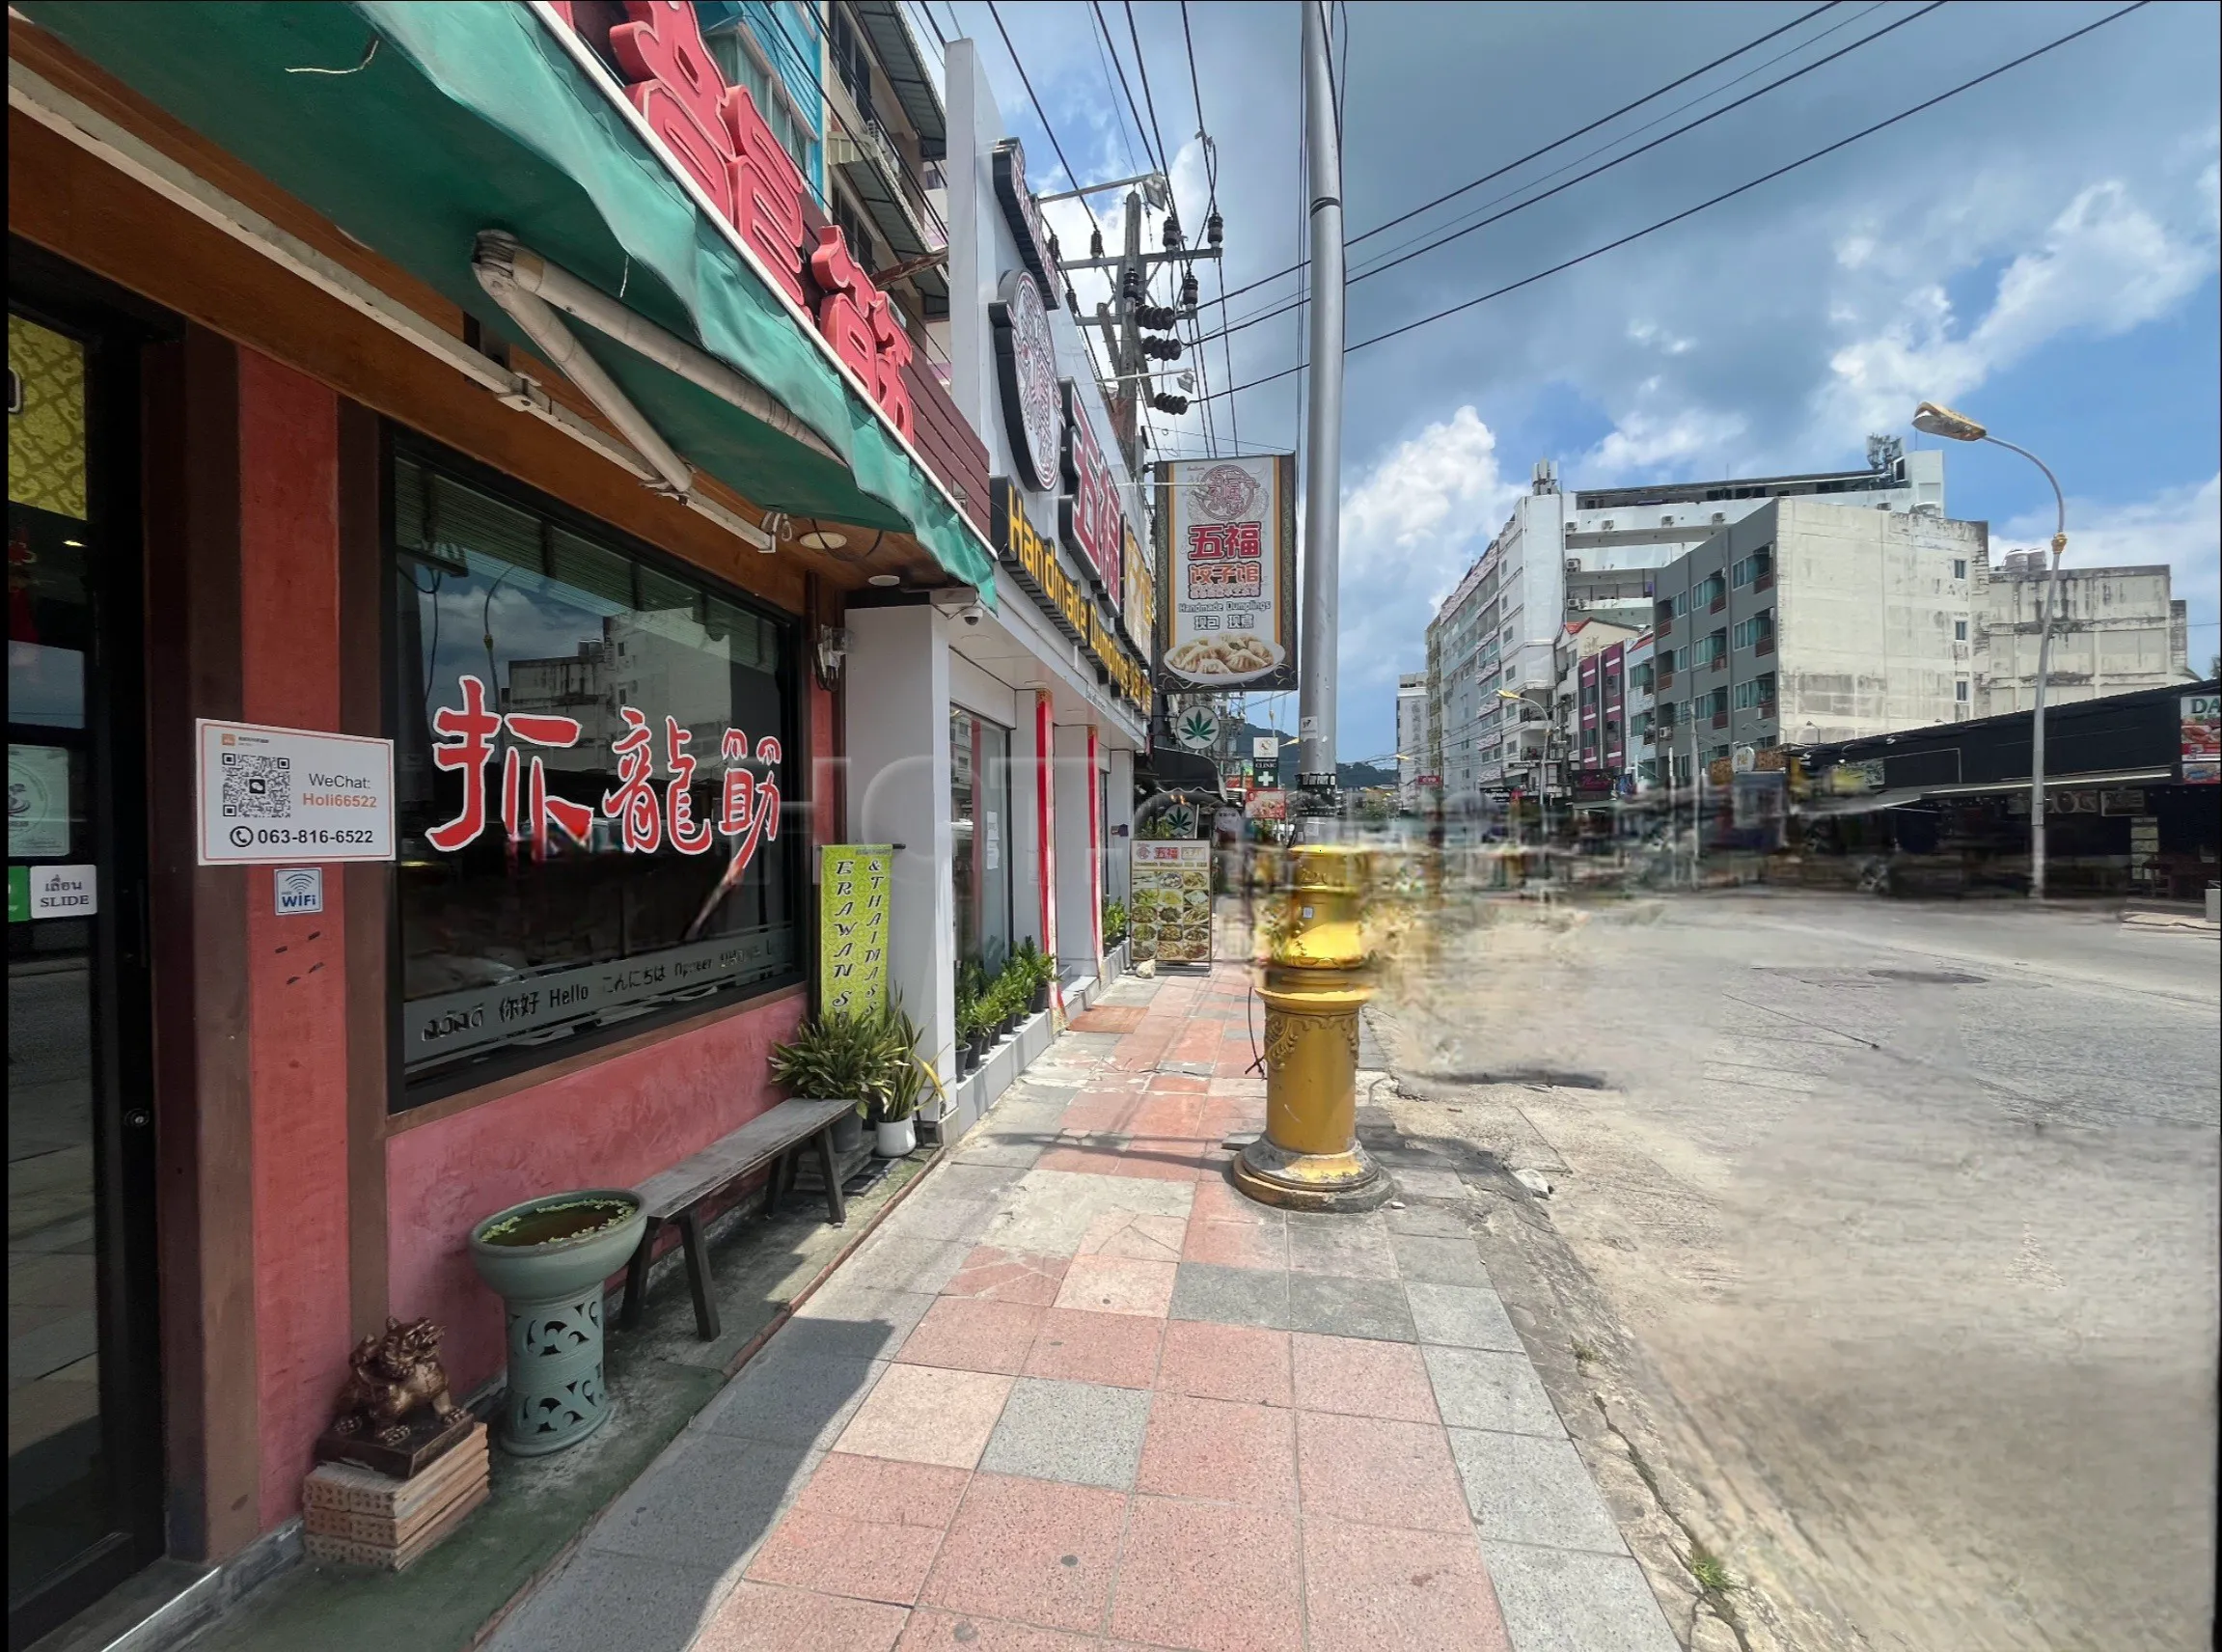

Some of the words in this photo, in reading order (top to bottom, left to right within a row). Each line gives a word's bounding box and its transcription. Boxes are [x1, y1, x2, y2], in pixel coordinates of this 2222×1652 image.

[1188, 522, 1262, 561] 五福
[1007, 484, 1088, 641] Handmade
[1178, 601, 1223, 613] Handmade
[1226, 599, 1271, 613] Dumplings
[309, 773, 371, 789] WeChat:
[303, 792, 378, 809] Holi66522
[258, 829, 373, 844] 063-816-6522
[868, 859, 881, 871] &
[40, 894, 90, 908] SLIDE
[867, 876, 885, 944] THAI
[834, 860, 858, 978] ERAWAN
[498, 990, 540, 1023] 你好
[549, 983, 590, 1008] Hello
[602, 964, 667, 994] こんにちは
